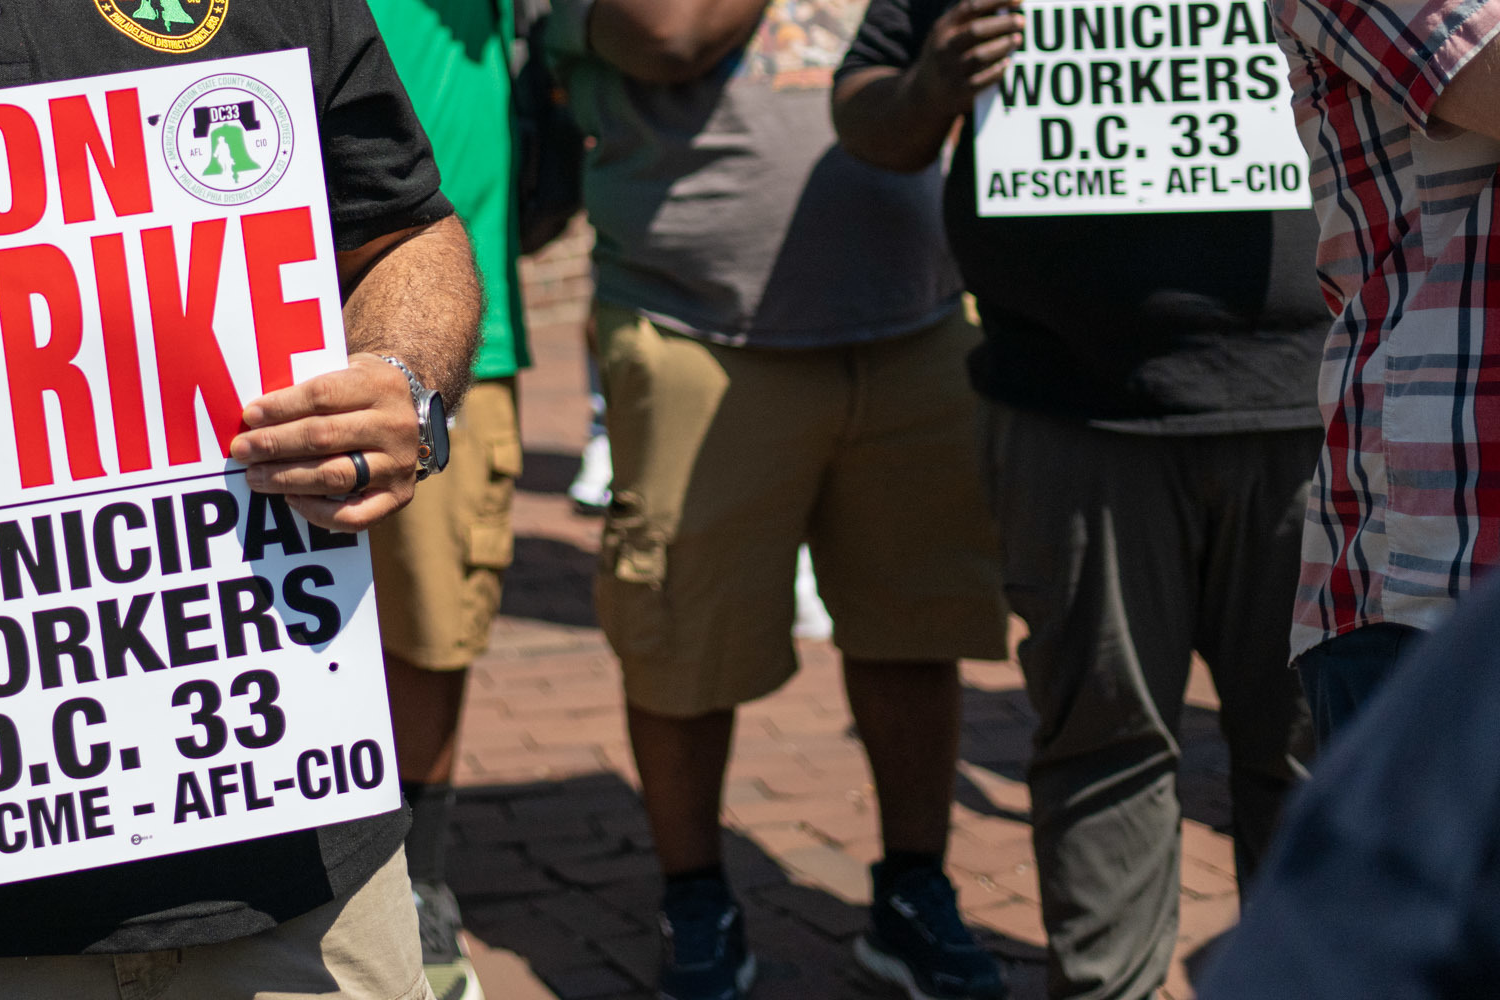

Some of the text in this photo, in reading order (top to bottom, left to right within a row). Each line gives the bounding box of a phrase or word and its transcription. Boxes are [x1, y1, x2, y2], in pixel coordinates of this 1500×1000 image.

[1012, 0, 1277, 52] UNICIPA
[1002, 55, 1280, 108] WORKERS
[210, 105, 240, 122] DC33
[1040, 112, 1239, 161] D.C. 33
[190, 138, 268, 157] AFL CIO
[988, 168, 1126, 199] AFSCME
[1166, 163, 1301, 195] AFL-CIO
[171, 669, 286, 760] 33
[173, 739, 385, 824] AFL-CIO
